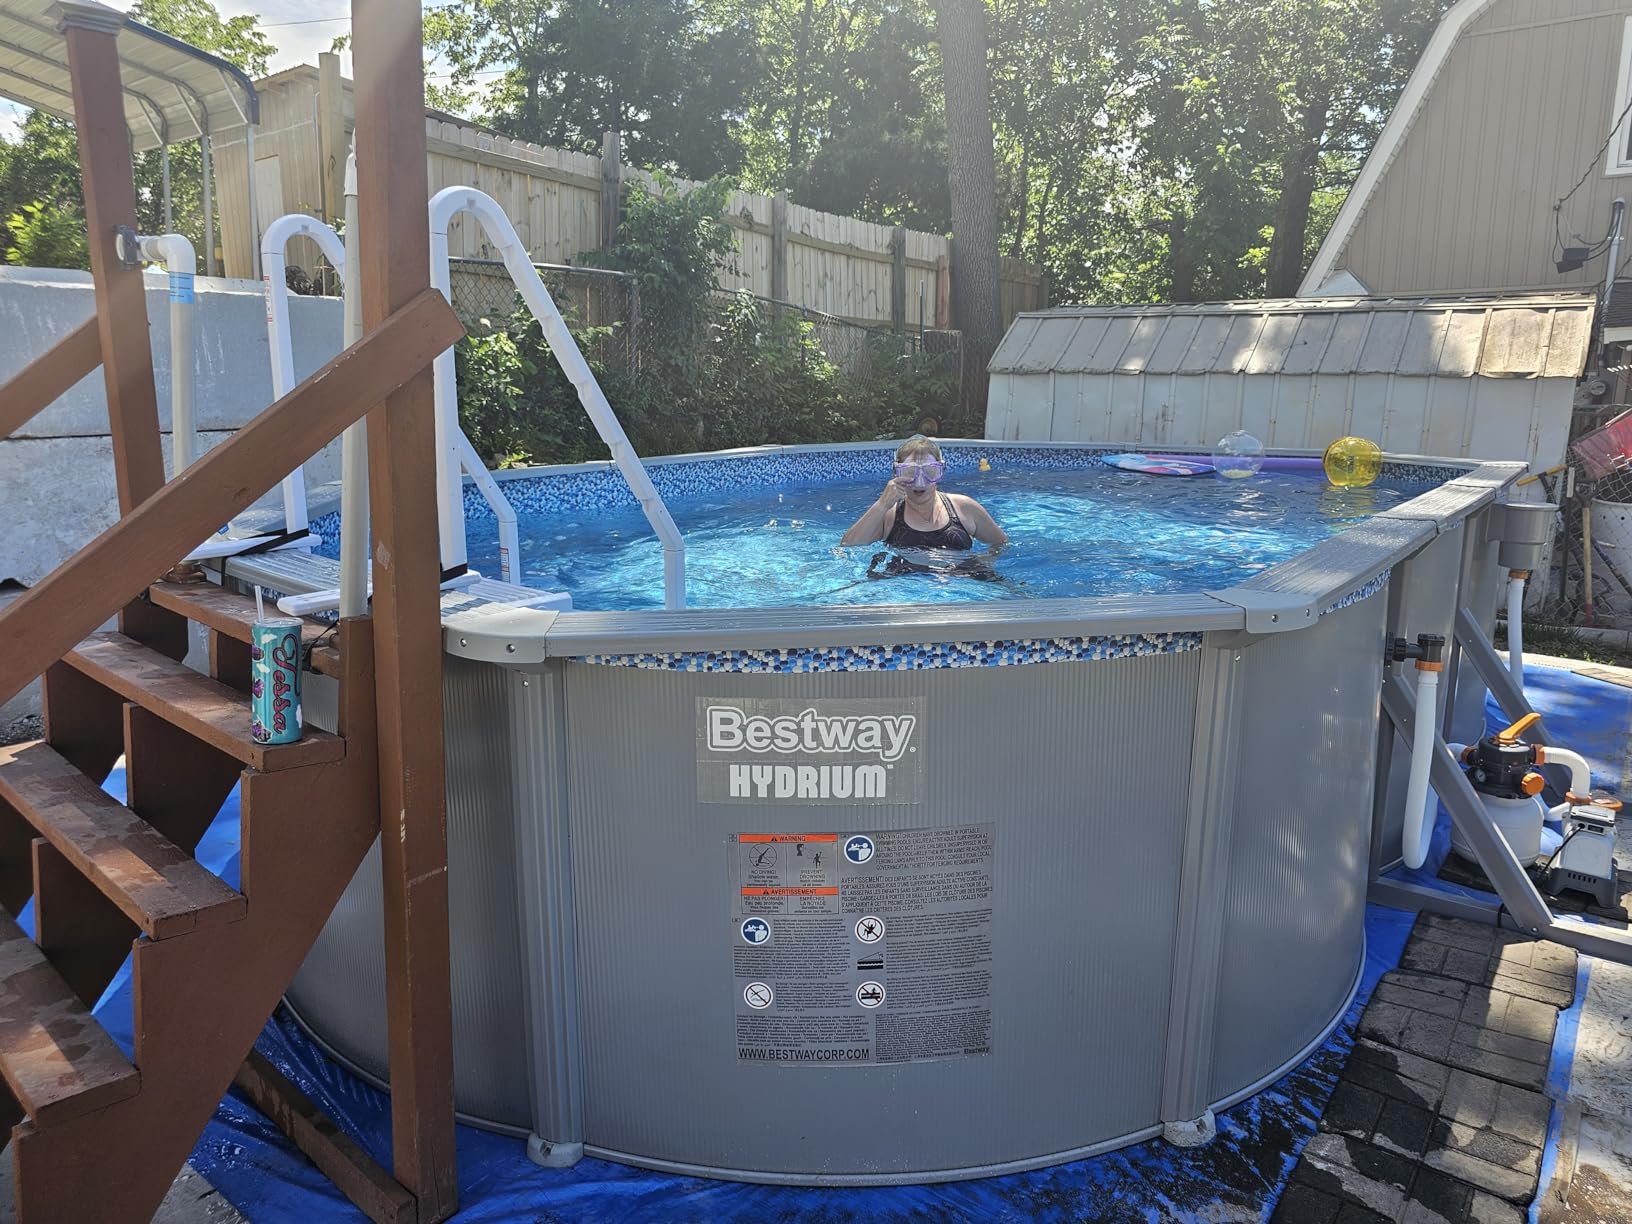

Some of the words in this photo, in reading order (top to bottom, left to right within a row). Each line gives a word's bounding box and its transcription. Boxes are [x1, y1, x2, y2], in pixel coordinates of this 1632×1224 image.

[707, 706, 916, 761] Bestway
[730, 764, 886, 798] HYDRIUM
[737, 1048, 870, 1060] WWW.BESTWAYCORP.COM
